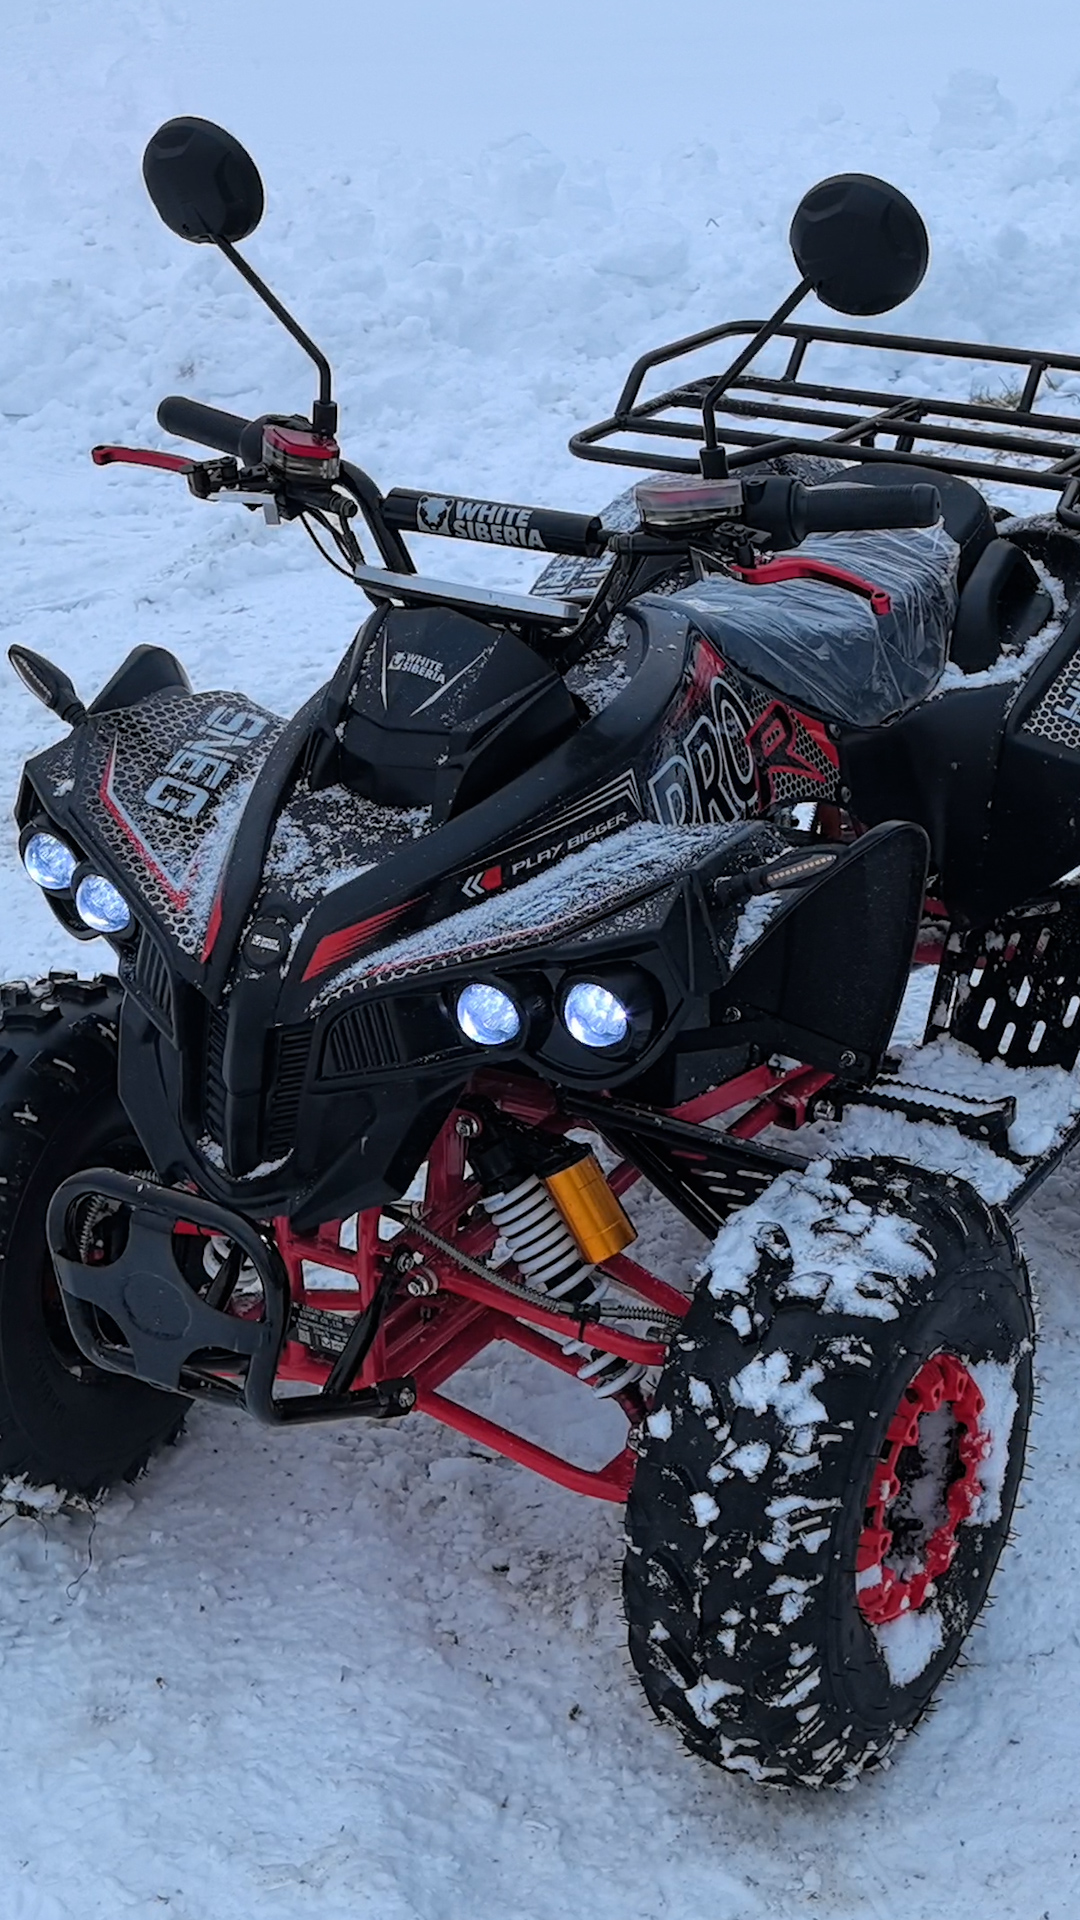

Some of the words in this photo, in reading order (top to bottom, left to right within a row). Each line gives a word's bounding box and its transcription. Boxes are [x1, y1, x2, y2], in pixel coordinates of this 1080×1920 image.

[455, 501, 533, 527] WHITE
[453, 520, 546, 549] SIBERIA
[401, 662, 446, 685] SIBERIA
[406, 653, 443, 673] WHITE
[143, 705, 271, 819] SNEG
[511, 842, 564, 875] PLAY
[567, 812, 628, 850] BIGGER
